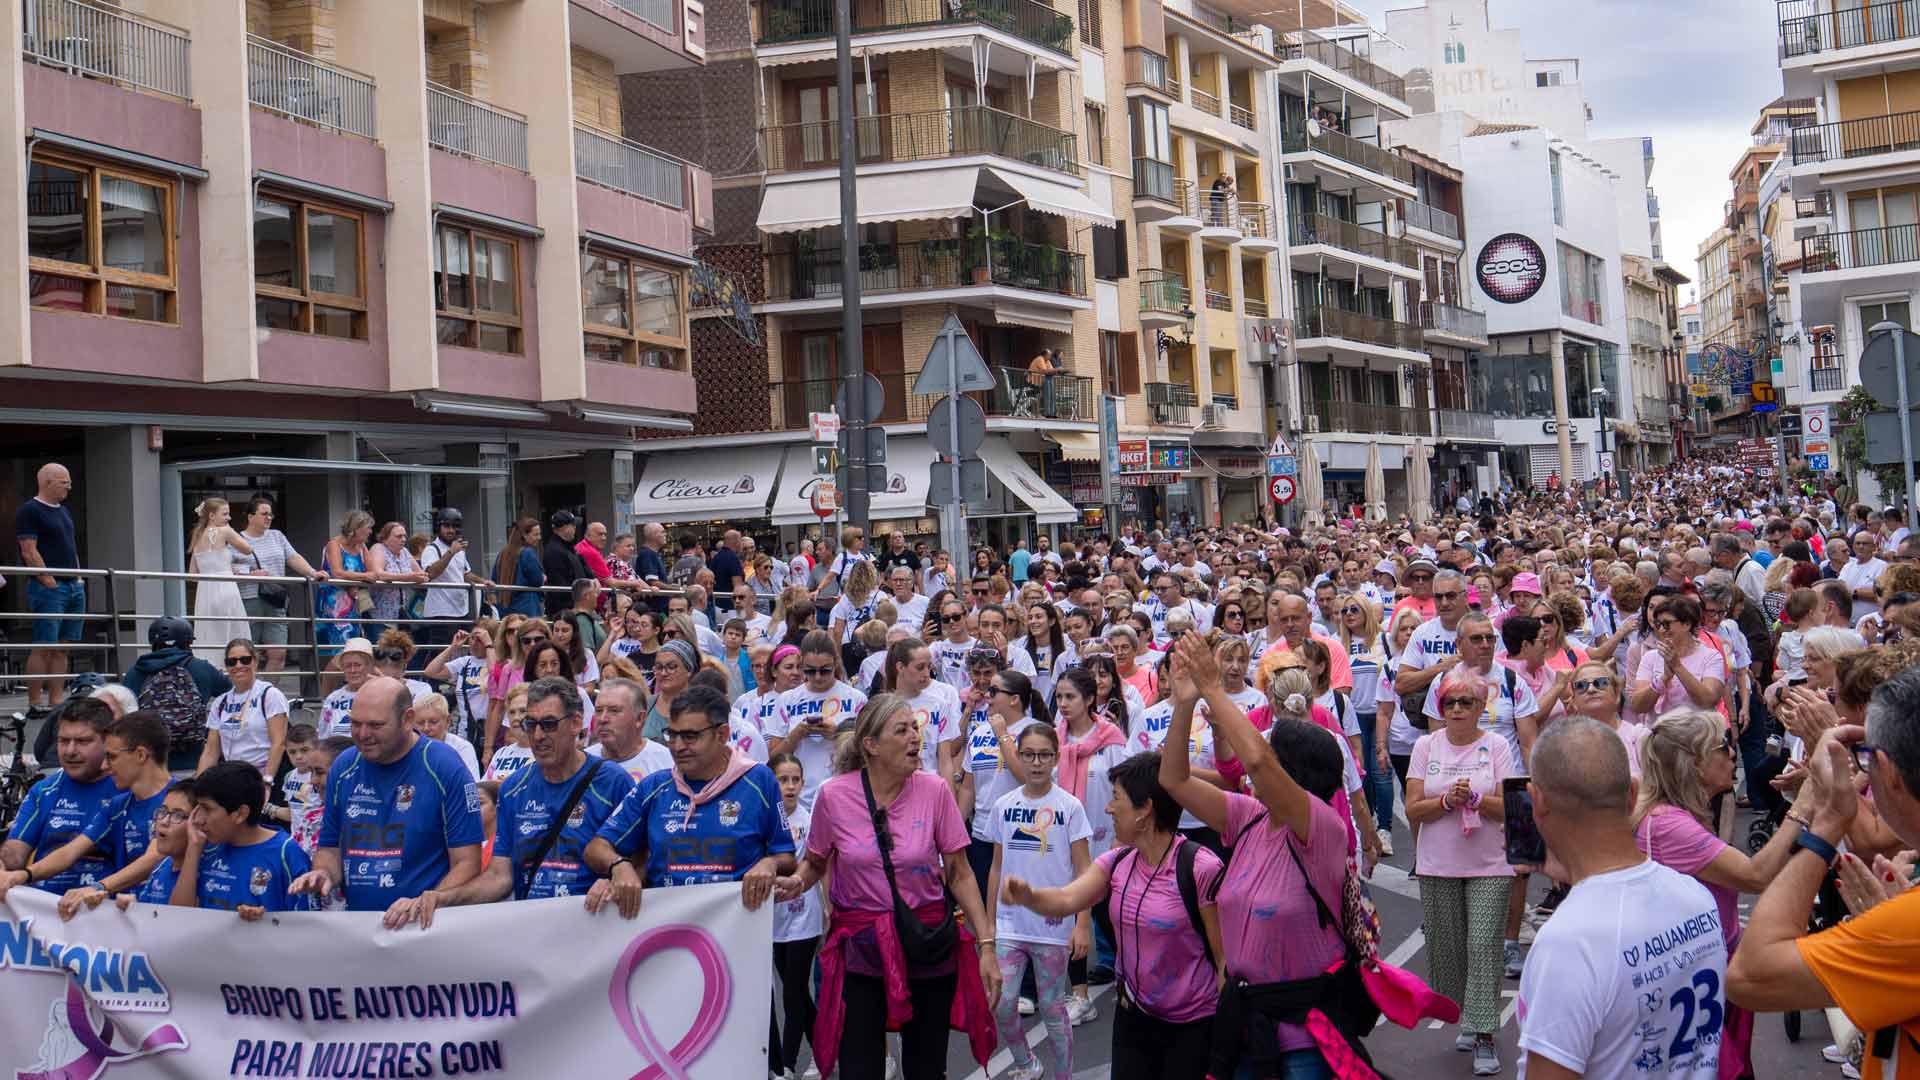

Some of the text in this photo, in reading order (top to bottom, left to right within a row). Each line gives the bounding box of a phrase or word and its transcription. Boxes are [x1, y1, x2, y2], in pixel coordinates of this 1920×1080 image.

[1482, 259, 1541, 275] COOL
[1120, 452, 1144, 463] RKET
[649, 480, 729, 499] Cueva
[0, 918, 166, 994] NEONA
[220, 980, 517, 1021] GRUPO DE AUTOAYUDA
[1669, 968, 1723, 1059] 23
[229, 1039, 503, 1079] PARA MUJERES CON
